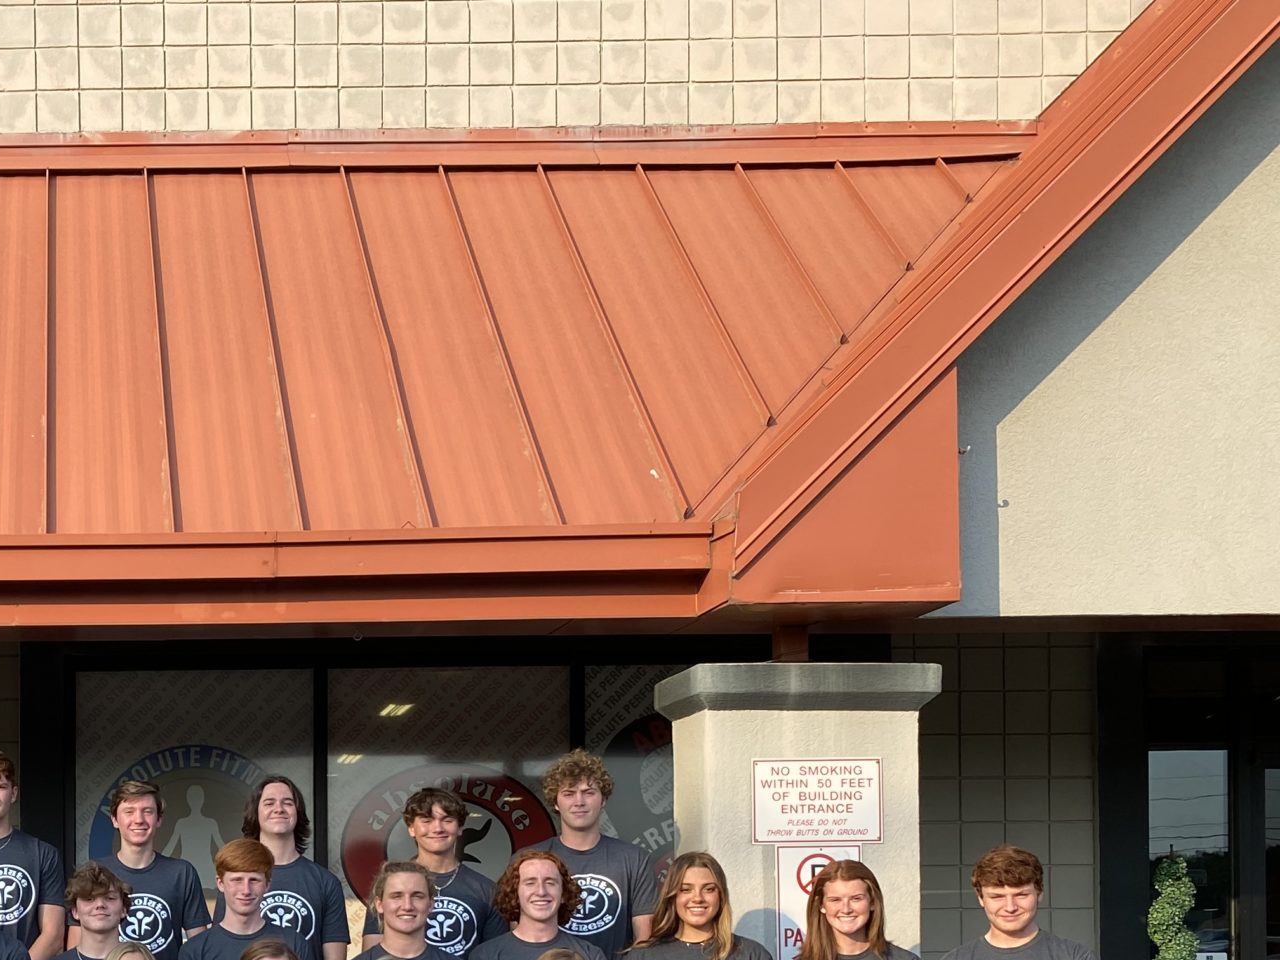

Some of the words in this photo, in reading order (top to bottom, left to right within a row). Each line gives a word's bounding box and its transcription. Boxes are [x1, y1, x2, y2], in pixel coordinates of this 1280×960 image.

[771, 766, 790, 776] NO
[799, 766, 863, 776] SMOKING
[761, 779, 808, 789] WITHIN
[817, 779, 832, 788] 50
[841, 778, 873, 787] FEET
[772, 792, 789, 801] OF
[799, 791, 863, 801] BUILDING
[367, 773, 531, 831] abolute
[781, 804, 854, 814] ENTRANCE
[832, 818, 847, 826] NOT
[260, 894, 308, 918] bsolute
